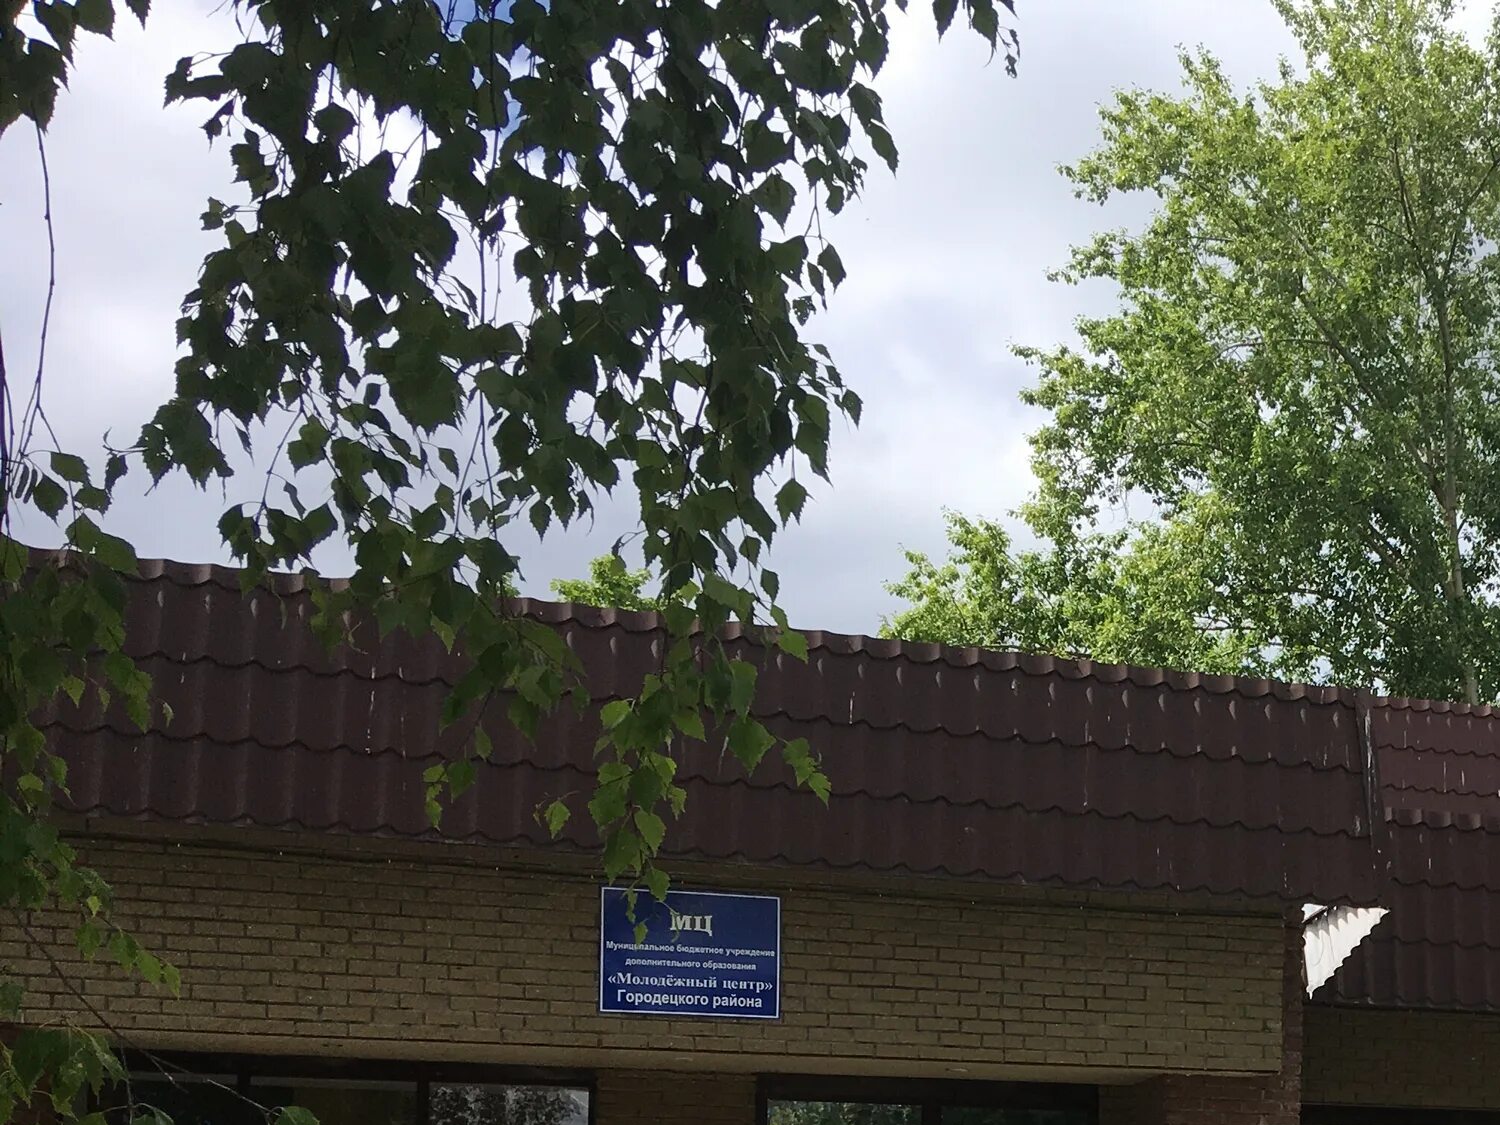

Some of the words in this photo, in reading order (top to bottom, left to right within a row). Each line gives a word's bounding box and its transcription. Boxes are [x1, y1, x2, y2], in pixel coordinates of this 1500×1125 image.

[670, 914, 713, 937] МЦ
[676, 944, 724, 955] бюджетное
[726, 947, 776, 958] учреждение
[625, 958, 701, 968] дополнительного
[703, 961, 757, 971] образования
[607, 972, 717, 988] «Молодёжный
[722, 980, 773, 993] центр»
[617, 989, 709, 1007] Городецкого
[713, 994, 763, 1008] района
